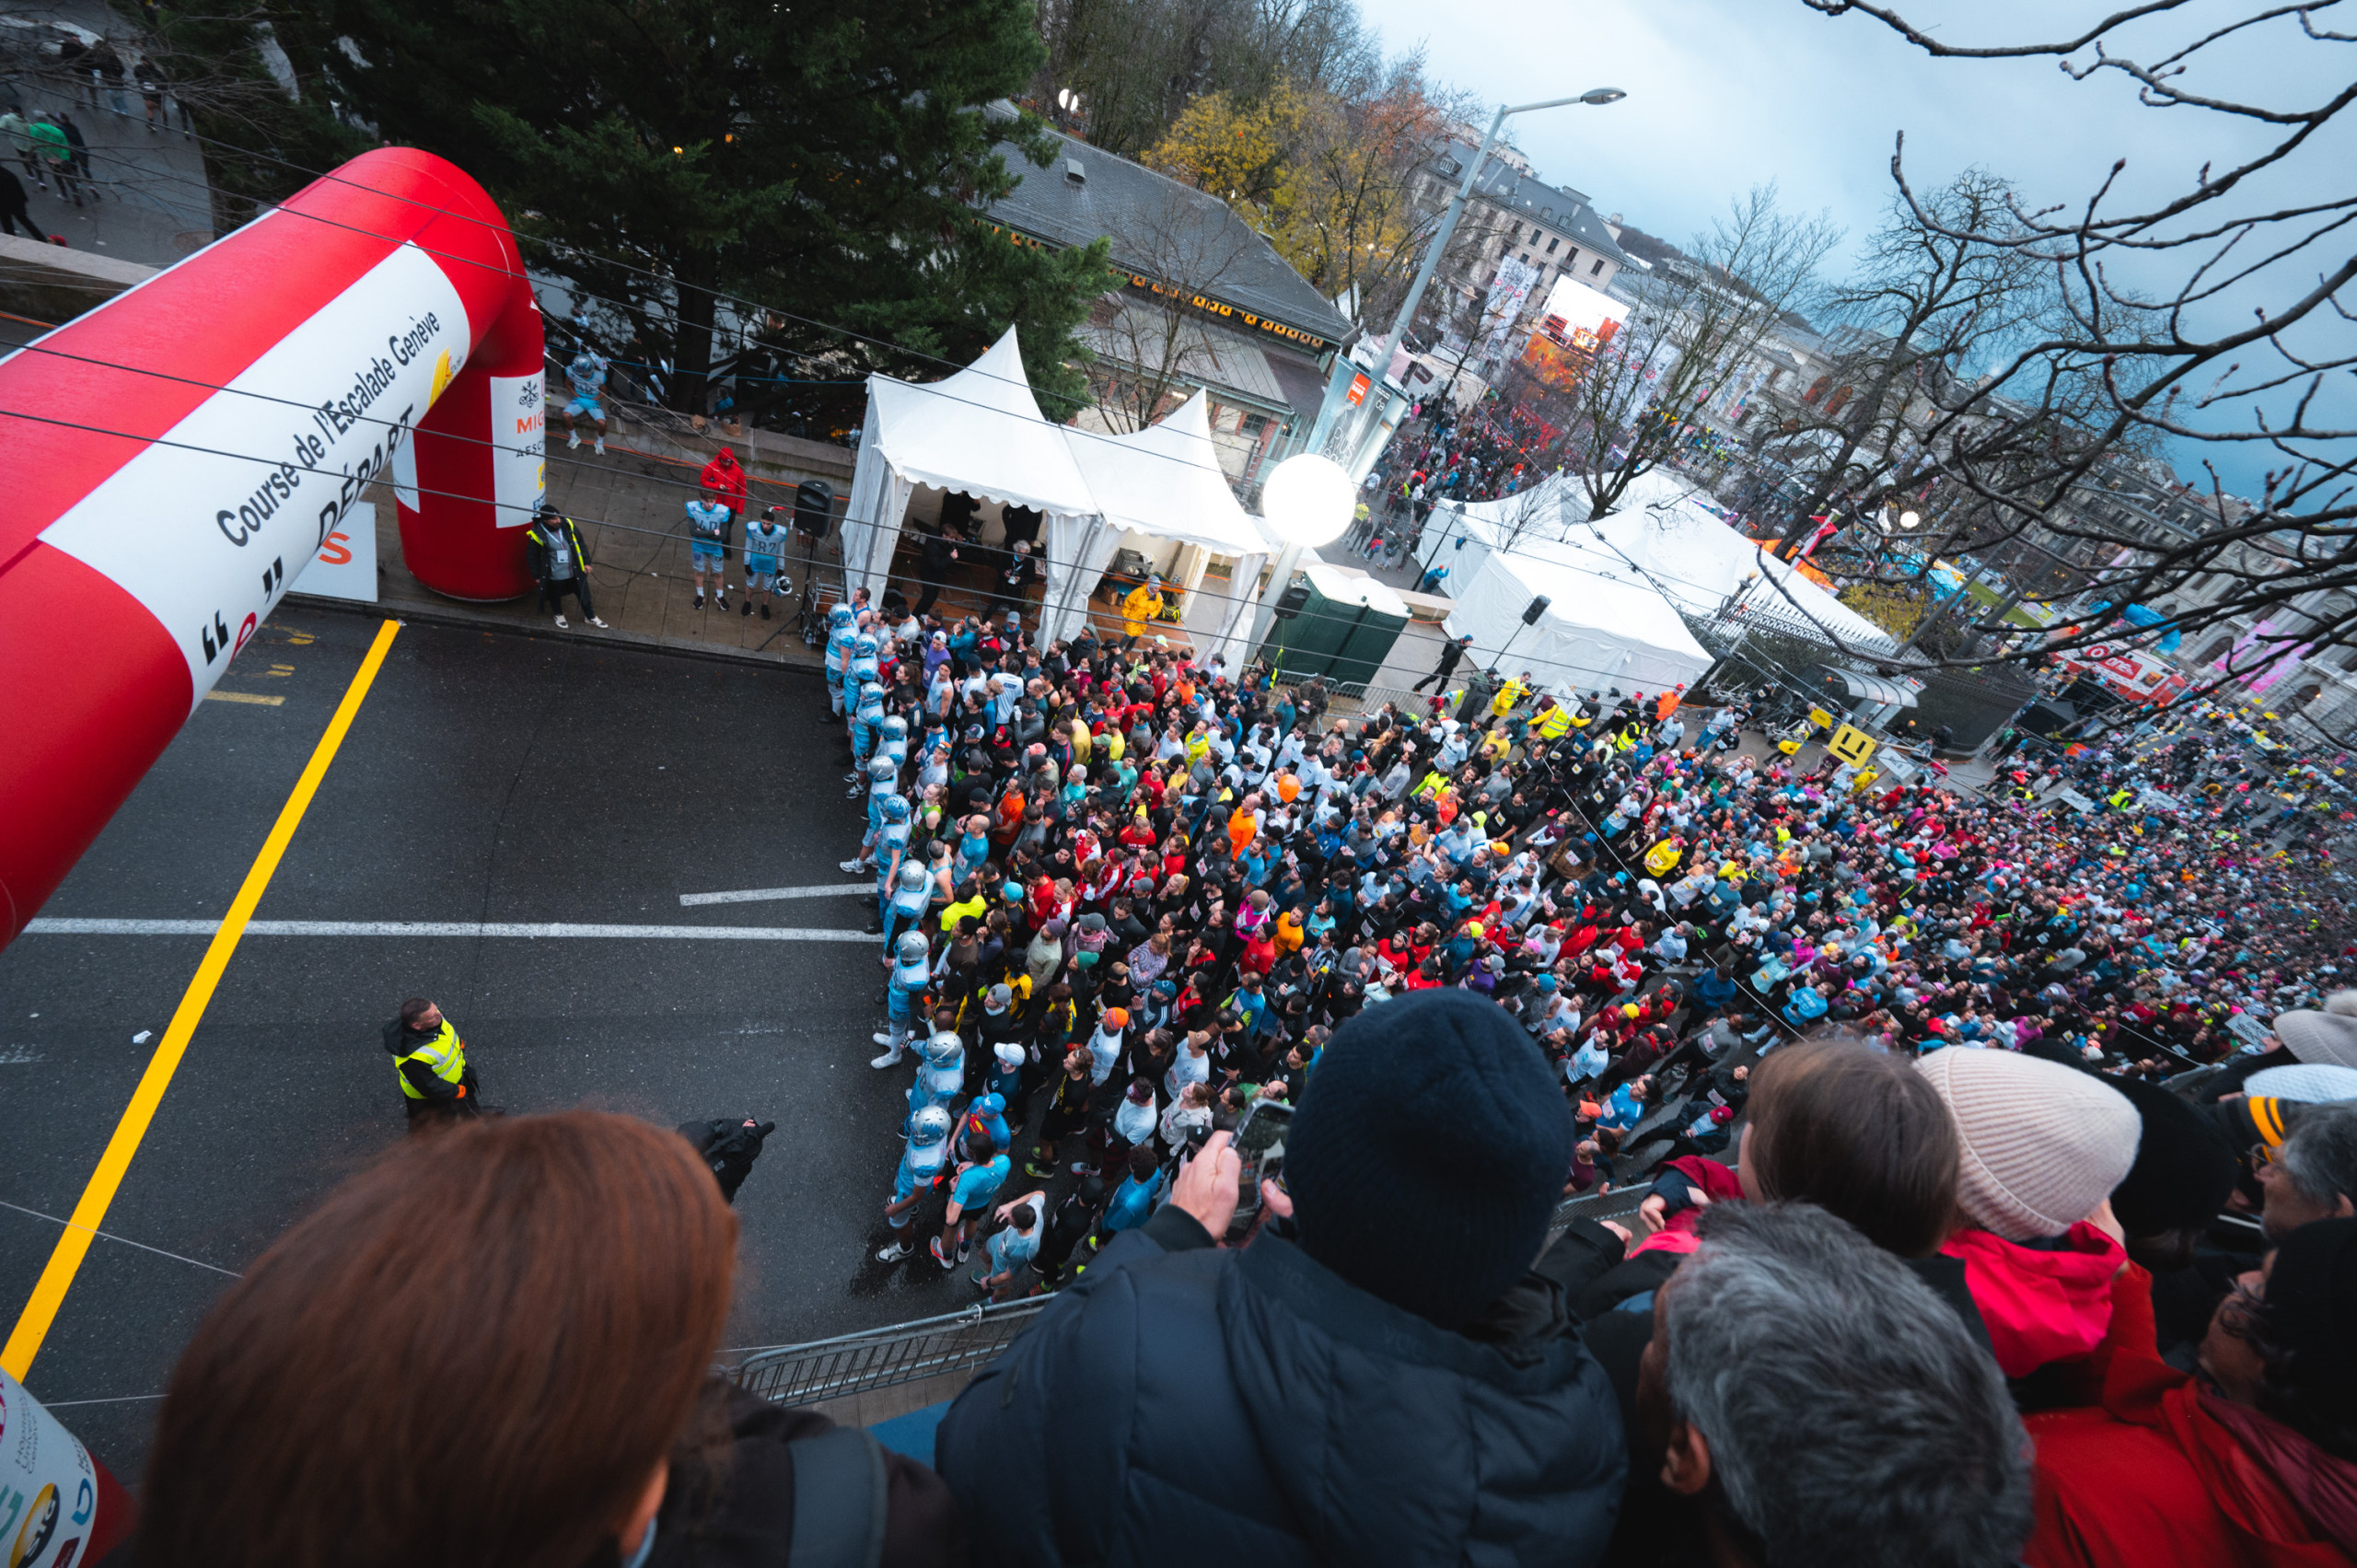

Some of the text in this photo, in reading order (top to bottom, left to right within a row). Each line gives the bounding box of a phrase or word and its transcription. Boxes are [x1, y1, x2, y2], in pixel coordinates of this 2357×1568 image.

[216, 311, 440, 548] Course de l'Escalade Genève
